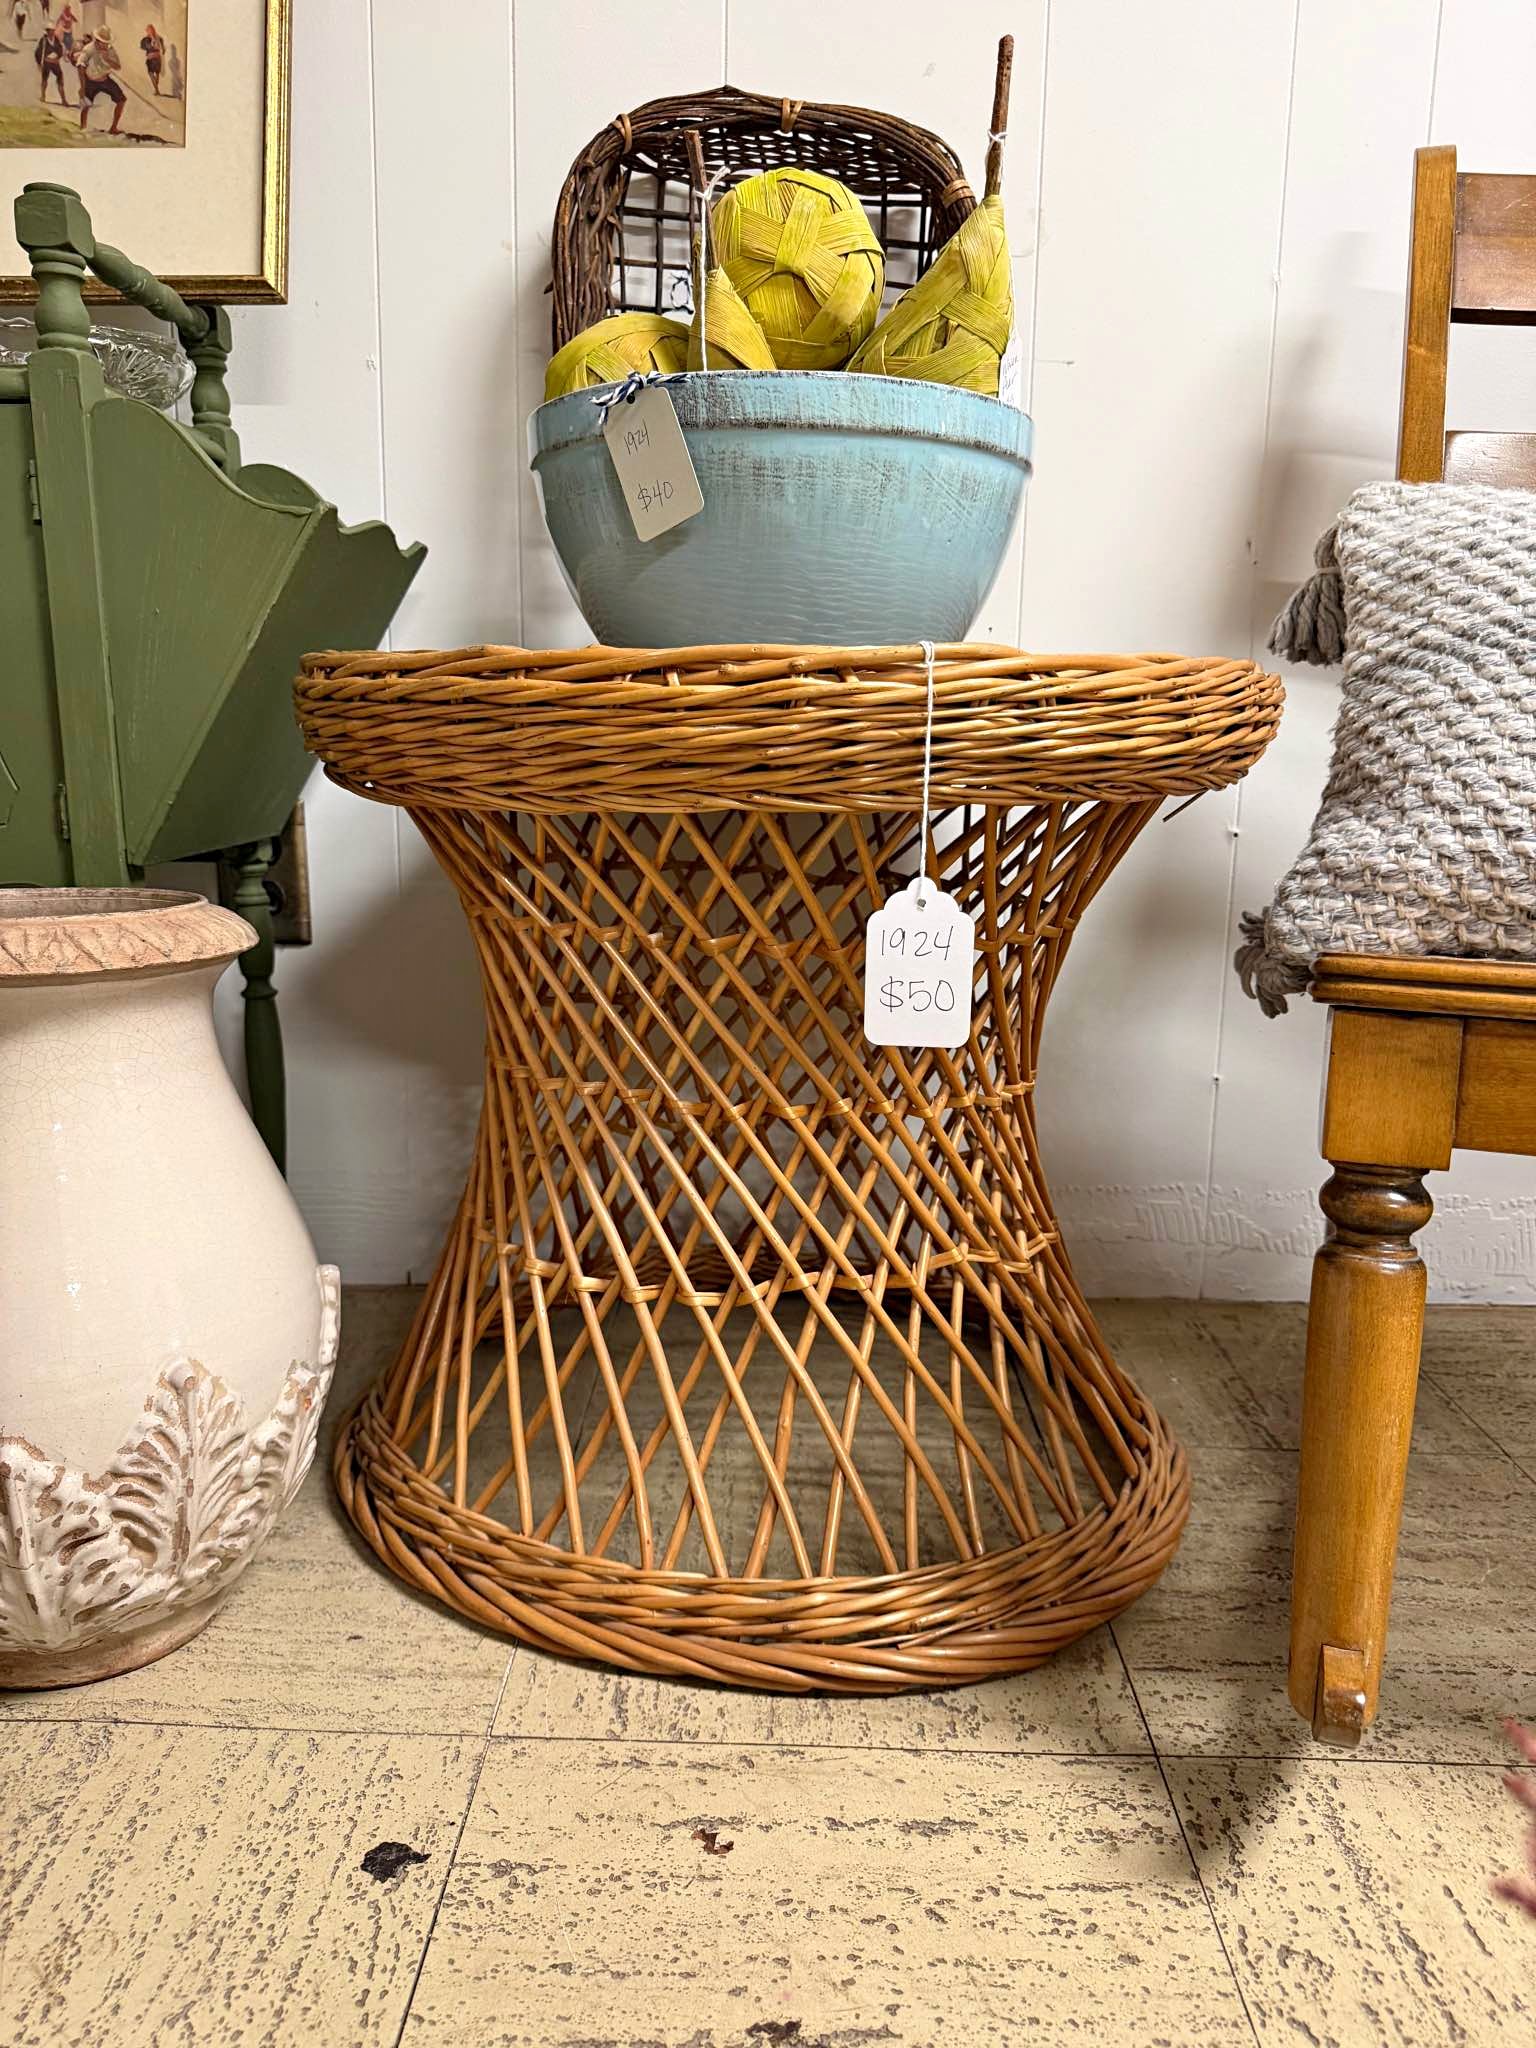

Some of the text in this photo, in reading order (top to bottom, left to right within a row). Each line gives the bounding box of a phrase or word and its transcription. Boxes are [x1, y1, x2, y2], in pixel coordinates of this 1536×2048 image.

[623, 419, 650, 455] 1924
[637, 480, 674, 512] $40
[881, 926, 954, 961] 1924
[879, 975, 955, 1013] $50
